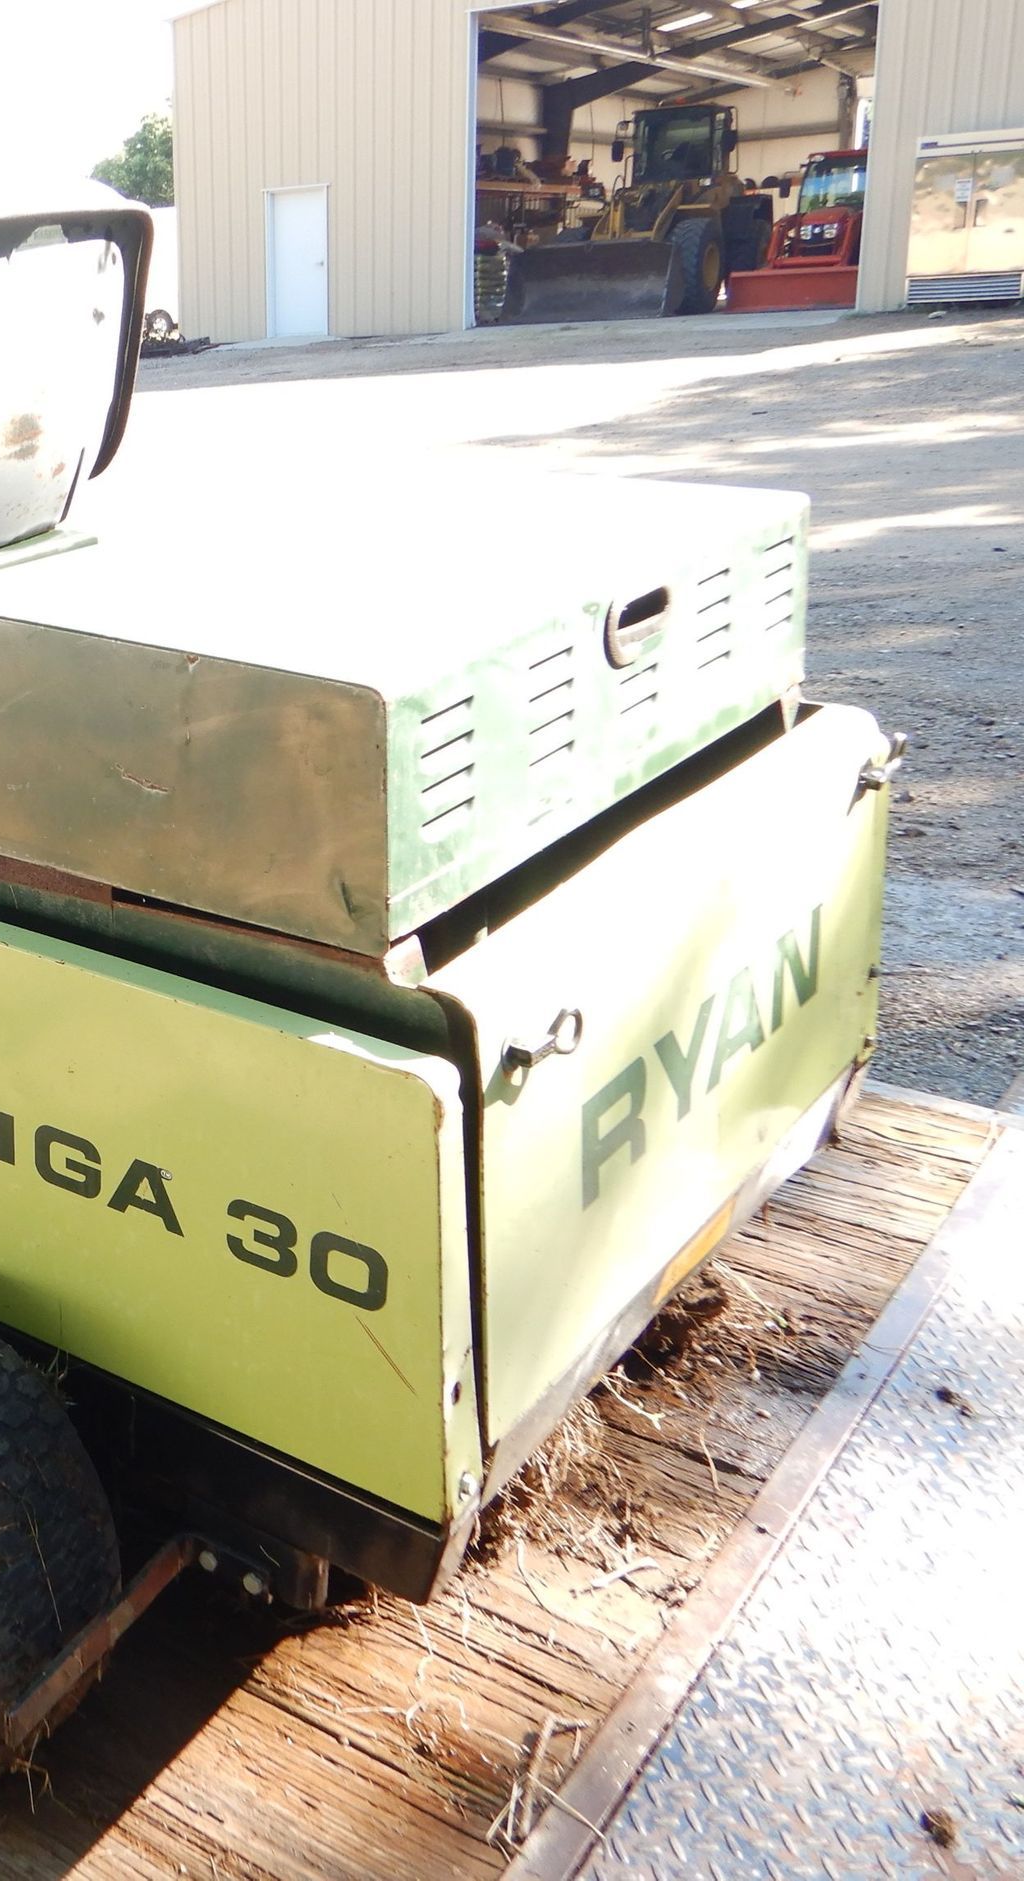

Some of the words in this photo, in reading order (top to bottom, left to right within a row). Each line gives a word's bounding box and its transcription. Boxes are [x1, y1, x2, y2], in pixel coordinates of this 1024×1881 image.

[581, 903, 824, 1212] RYAN
[34, 1124, 185, 1238] GA
[226, 1198, 389, 1312] 30
